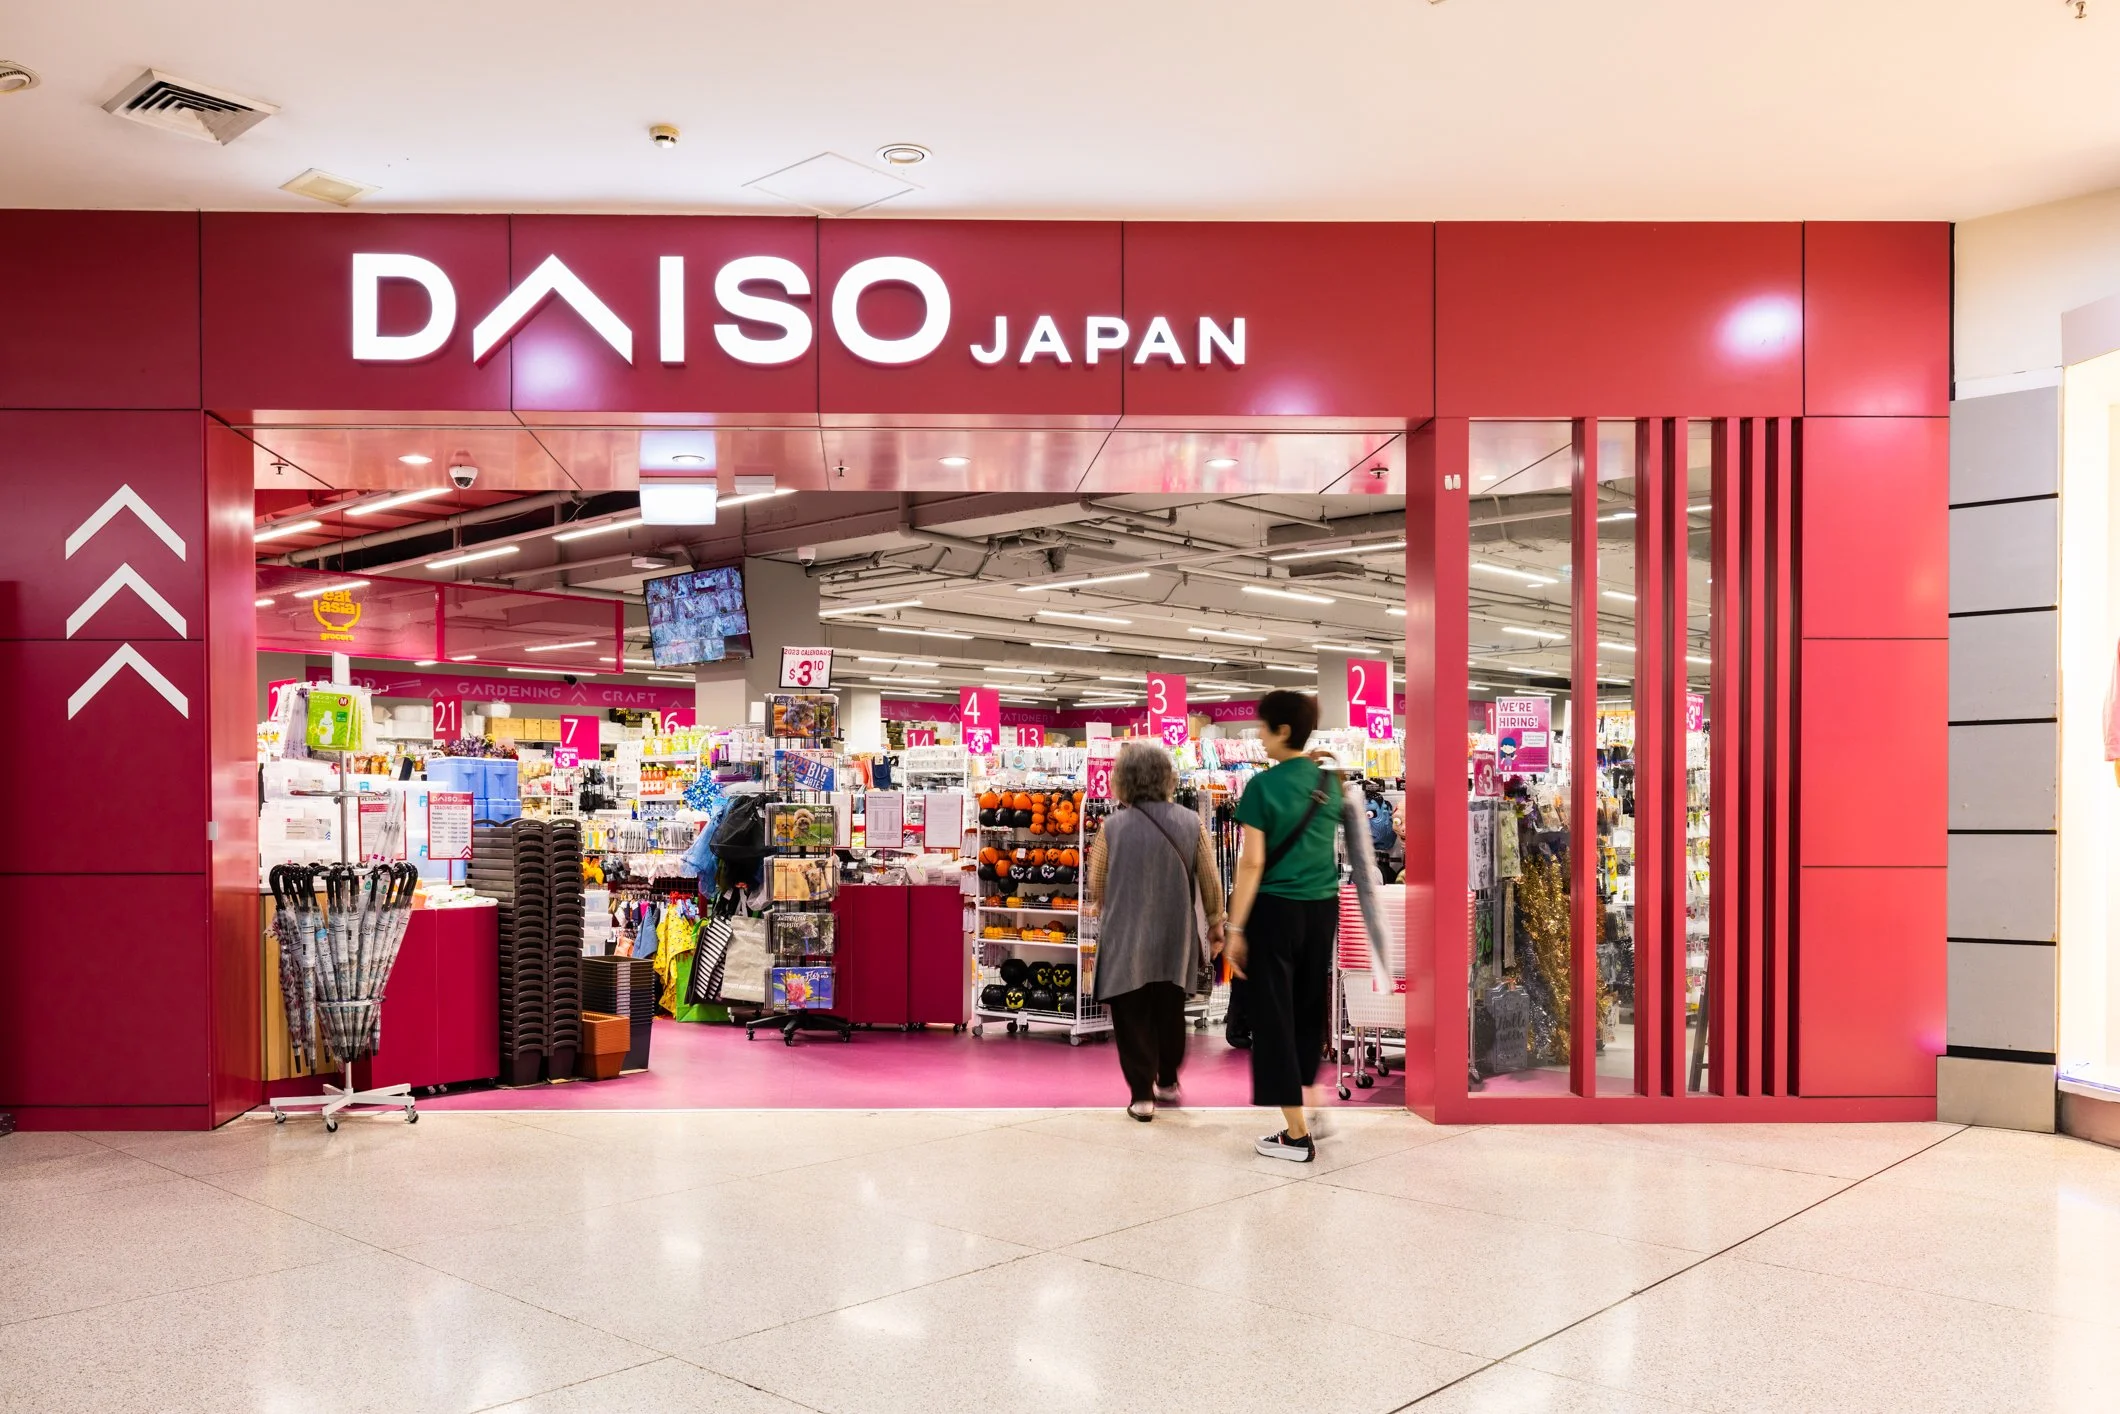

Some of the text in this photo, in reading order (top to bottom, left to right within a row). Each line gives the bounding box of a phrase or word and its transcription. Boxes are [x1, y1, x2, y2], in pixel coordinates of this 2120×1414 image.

[351, 252, 1247, 367] DAISO JAPAN
[322, 589, 352, 603] eat
[319, 601, 356, 615] asia
[783, 648, 832, 657] 2023 CALENDARS
[457, 682, 561, 700] GARDENING
[1351, 665, 1367, 705] 2
[339, 697, 348, 705] M
[602, 690, 657, 704] CRAFT
[1151, 678, 1168, 715] 3
[963, 691, 981, 725] 4
[1214, 706, 1255, 717] DAISO
[1498, 702, 1532, 712] WE'RE
[435, 700, 457, 733] 21
[664, 711, 681, 735] 6
[1499, 716, 1539, 728] HIRING!
[563, 718, 579, 744] 7
[909, 732, 930, 747] 14
[1019, 727, 1040, 748] 13
[806, 761, 829, 783] BIG
